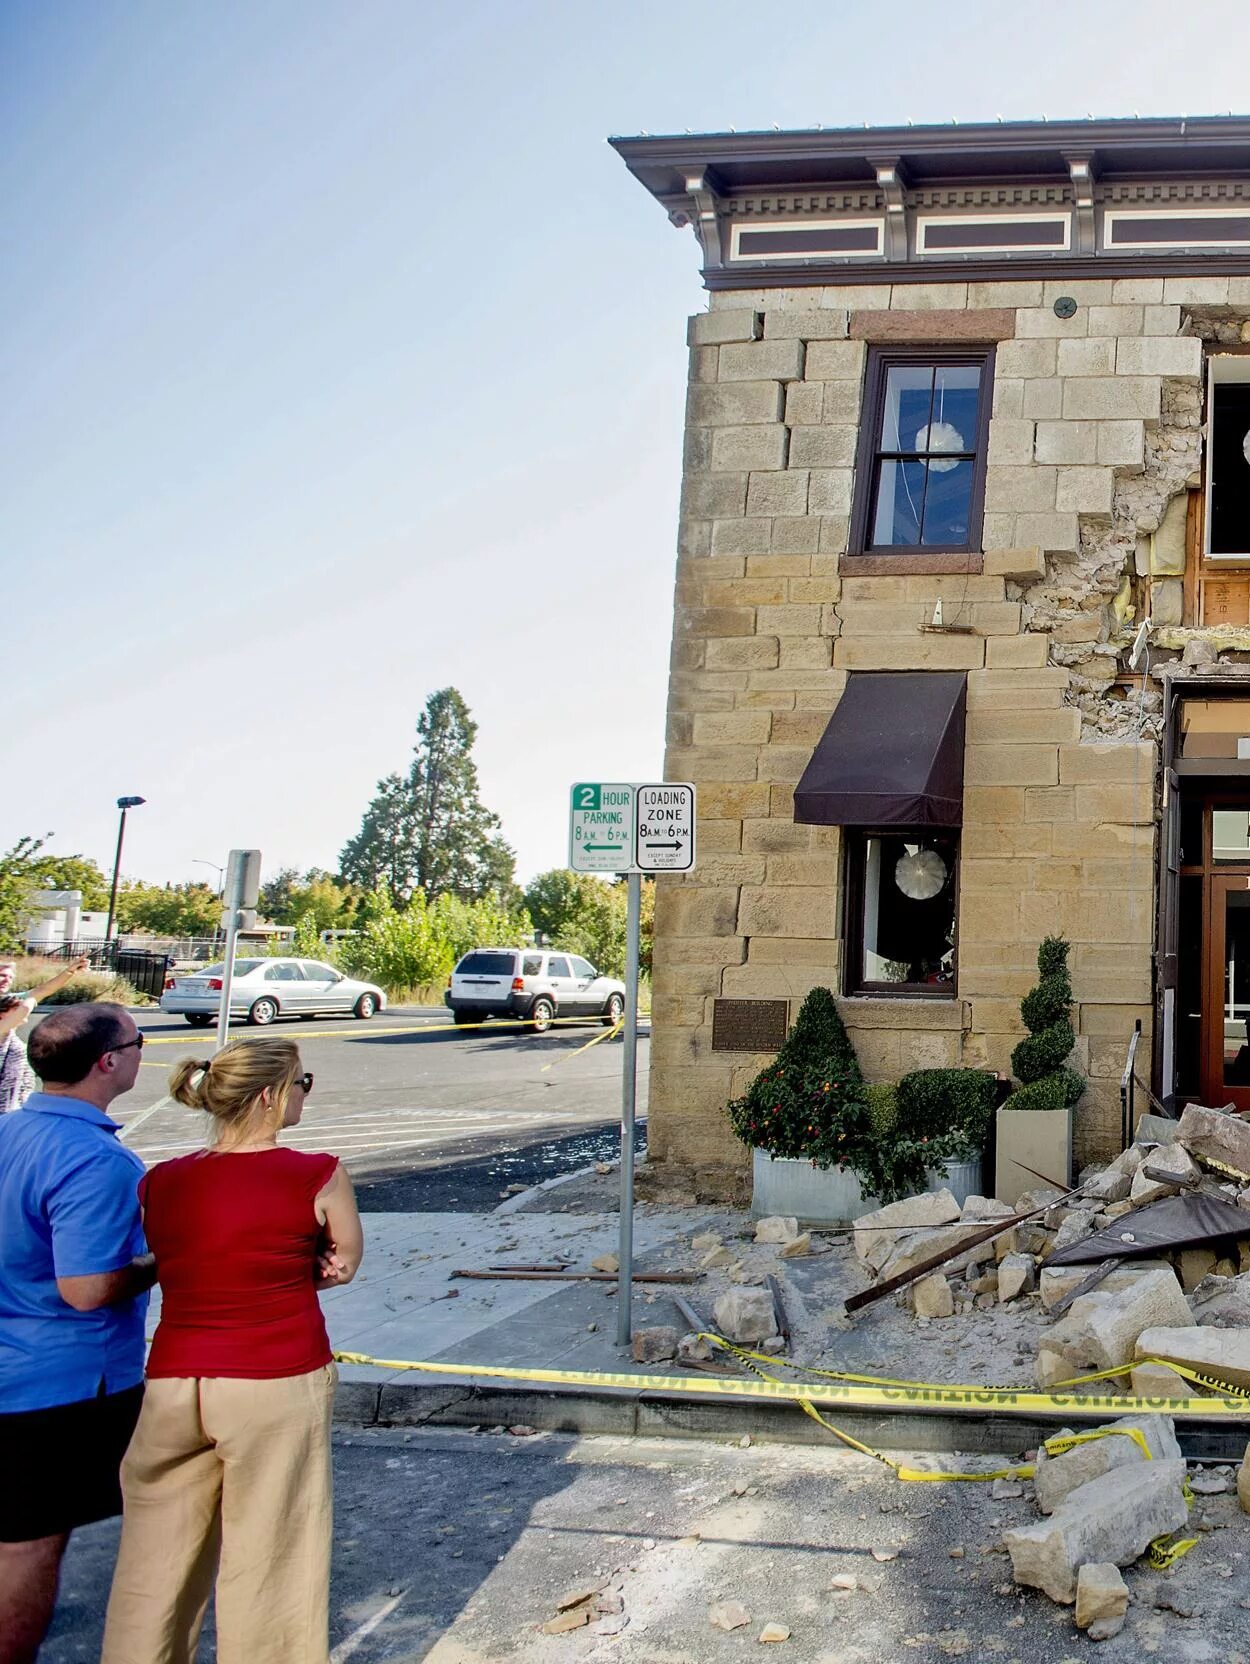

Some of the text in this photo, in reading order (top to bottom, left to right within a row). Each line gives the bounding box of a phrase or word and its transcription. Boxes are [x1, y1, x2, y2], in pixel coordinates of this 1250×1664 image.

[580, 787, 630, 807] 2 HOUR
[644, 792, 686, 805] LOADING
[583, 812, 623, 825] PARKING
[647, 809, 682, 821] ZONE
